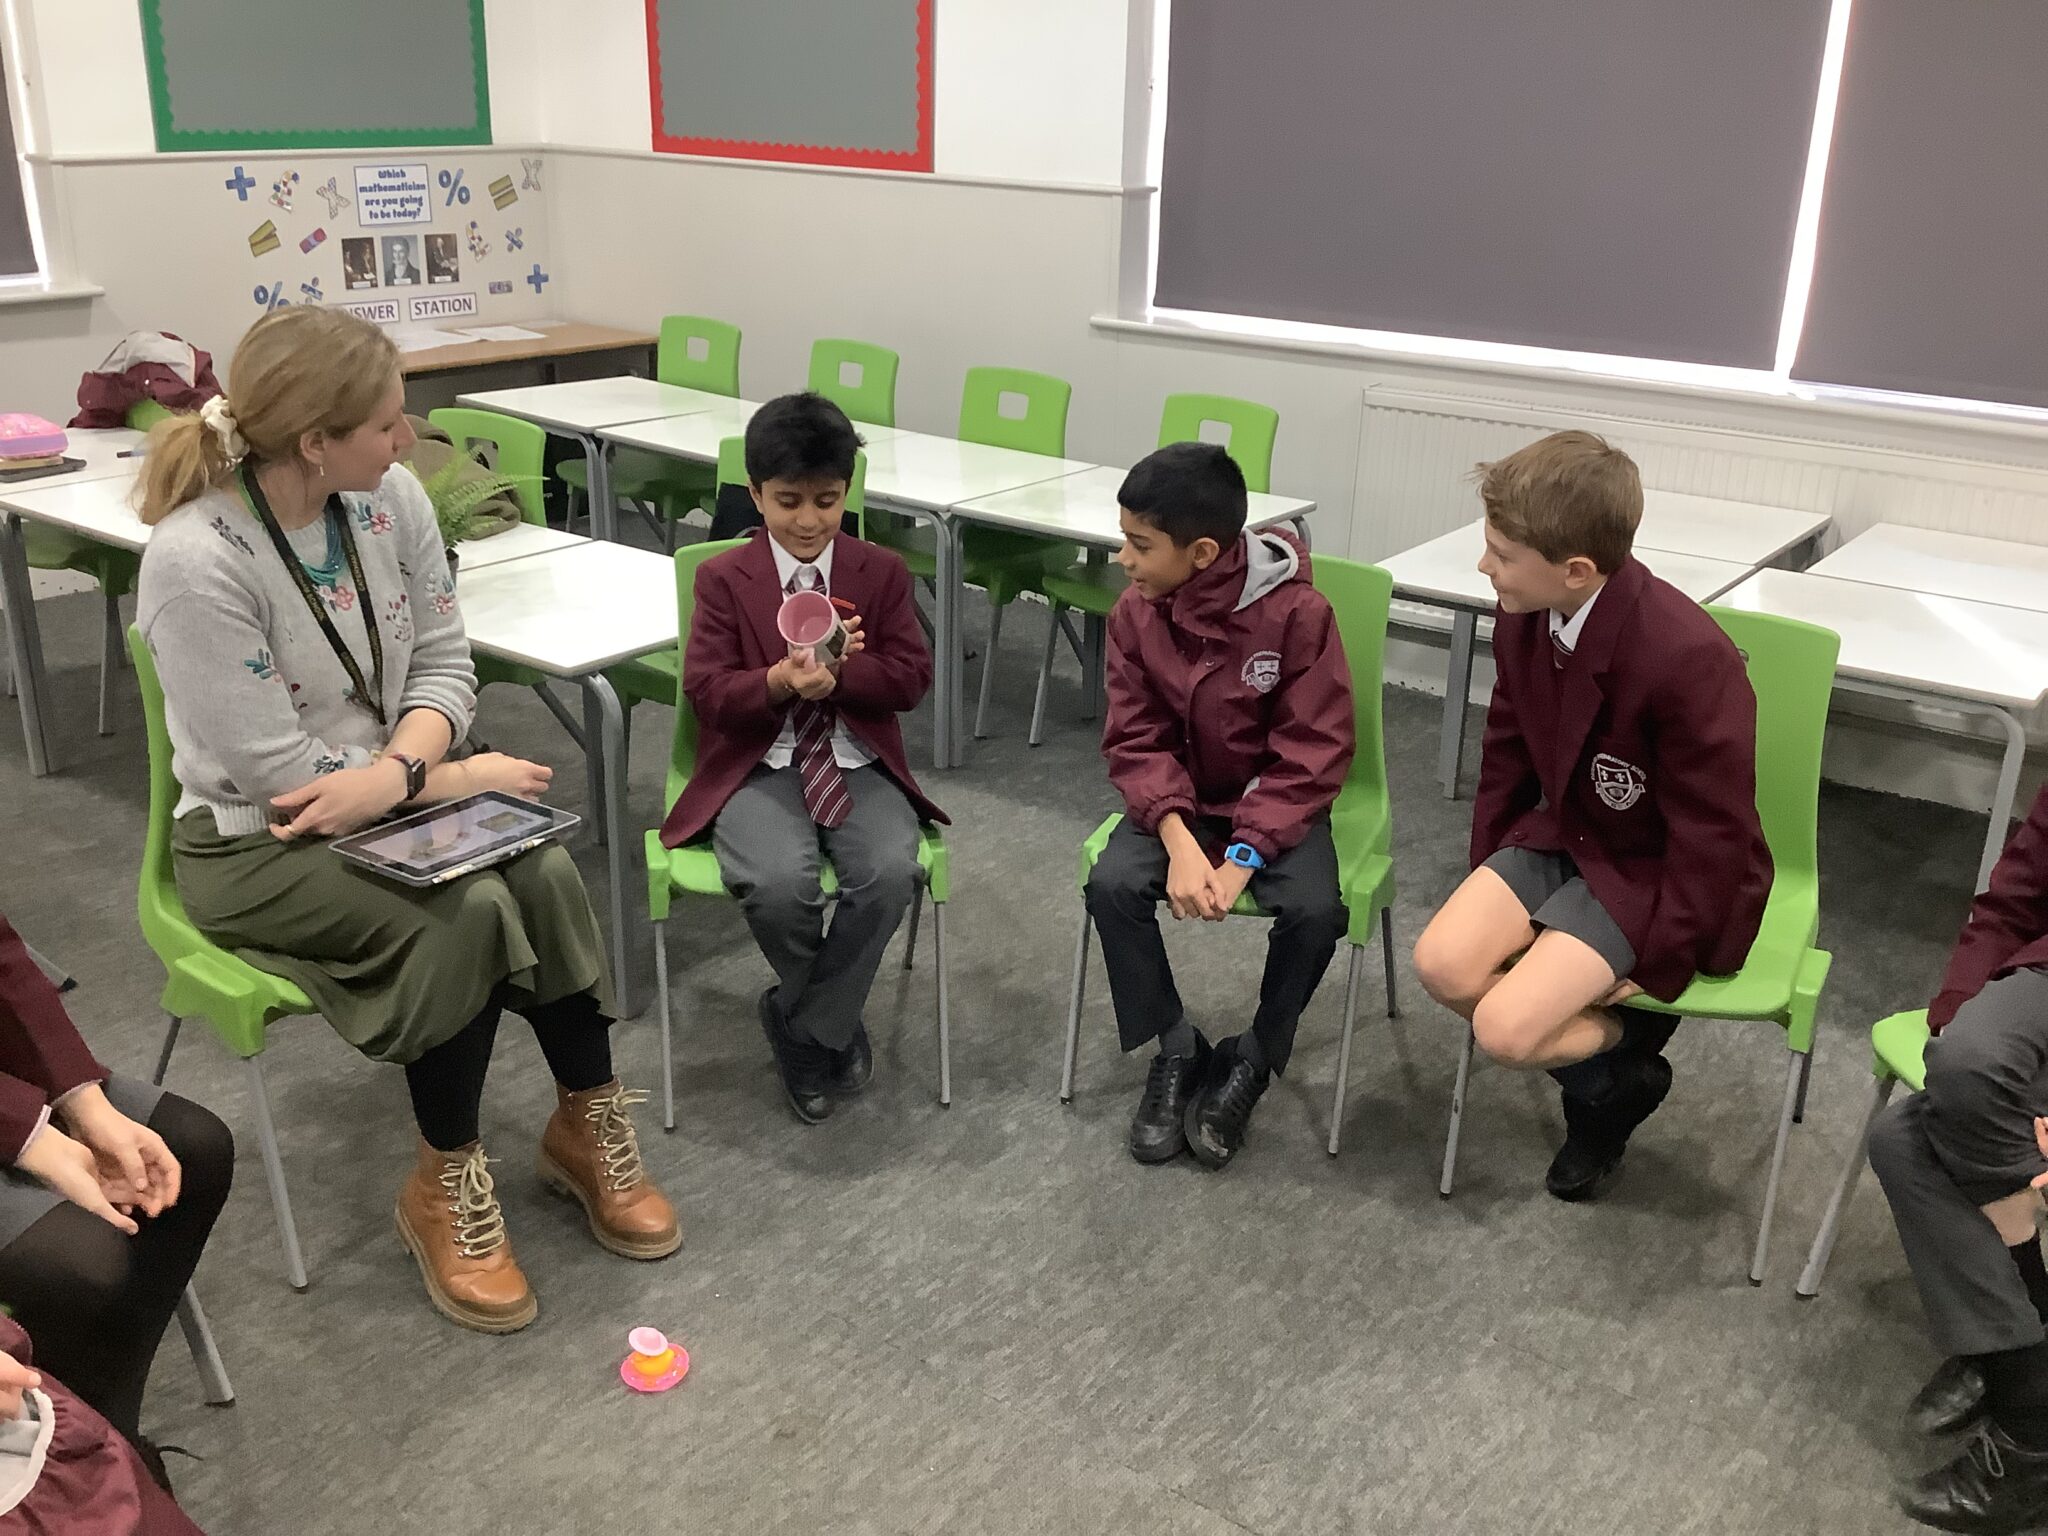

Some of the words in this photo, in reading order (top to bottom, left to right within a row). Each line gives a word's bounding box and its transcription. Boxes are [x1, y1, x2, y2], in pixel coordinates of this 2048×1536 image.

[378, 168, 406, 179] Which
[359, 181, 426, 193] mathematician
[365, 198, 380, 206] are
[382, 198, 398, 208] you
[399, 194, 423, 208] going
[369, 210, 379, 219] to
[380, 209, 391, 219] be
[392, 207, 421, 220] today?
[350, 304, 395, 320] SWER
[414, 298, 473, 316] STATION
